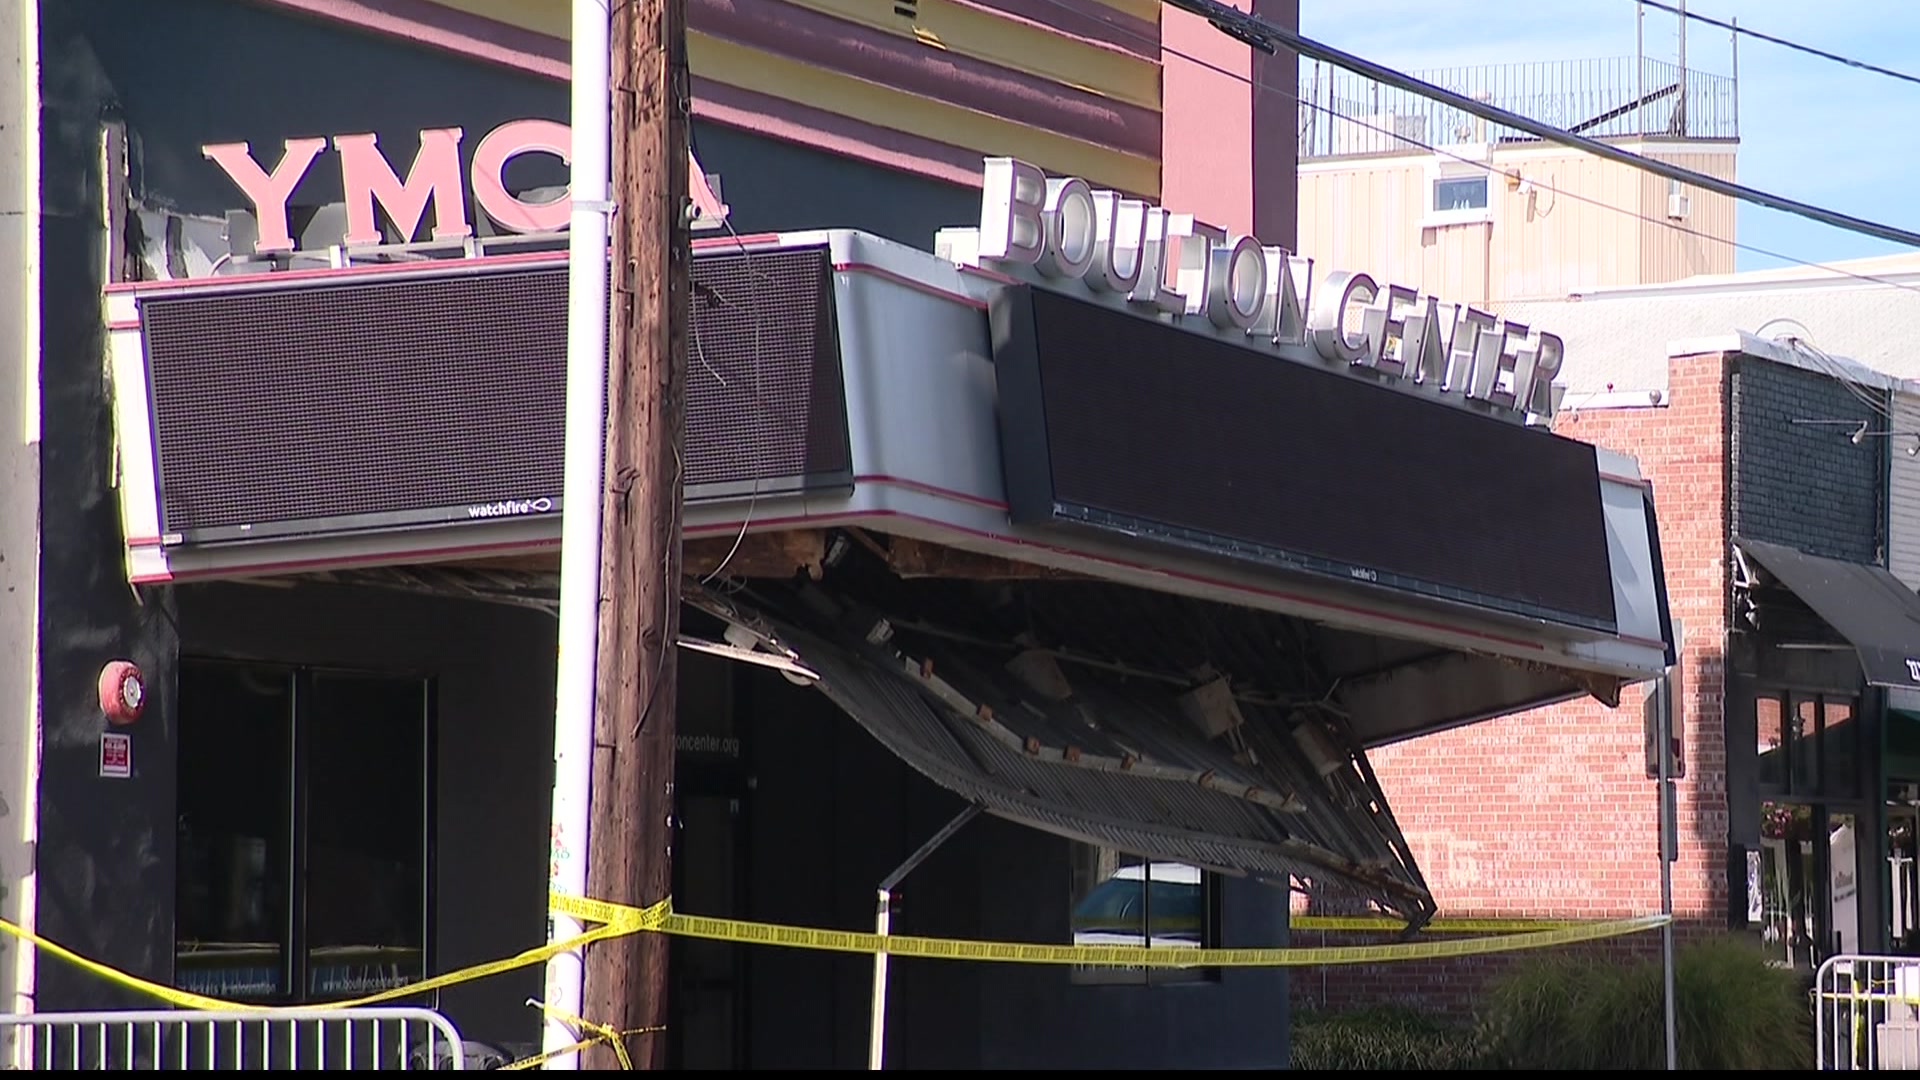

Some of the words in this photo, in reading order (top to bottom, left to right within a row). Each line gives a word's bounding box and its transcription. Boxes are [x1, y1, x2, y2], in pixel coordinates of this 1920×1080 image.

[979, 157, 1314, 346] BOULTON
[1312, 271, 1566, 432] CENTER
[468, 500, 528, 518] watchfire
